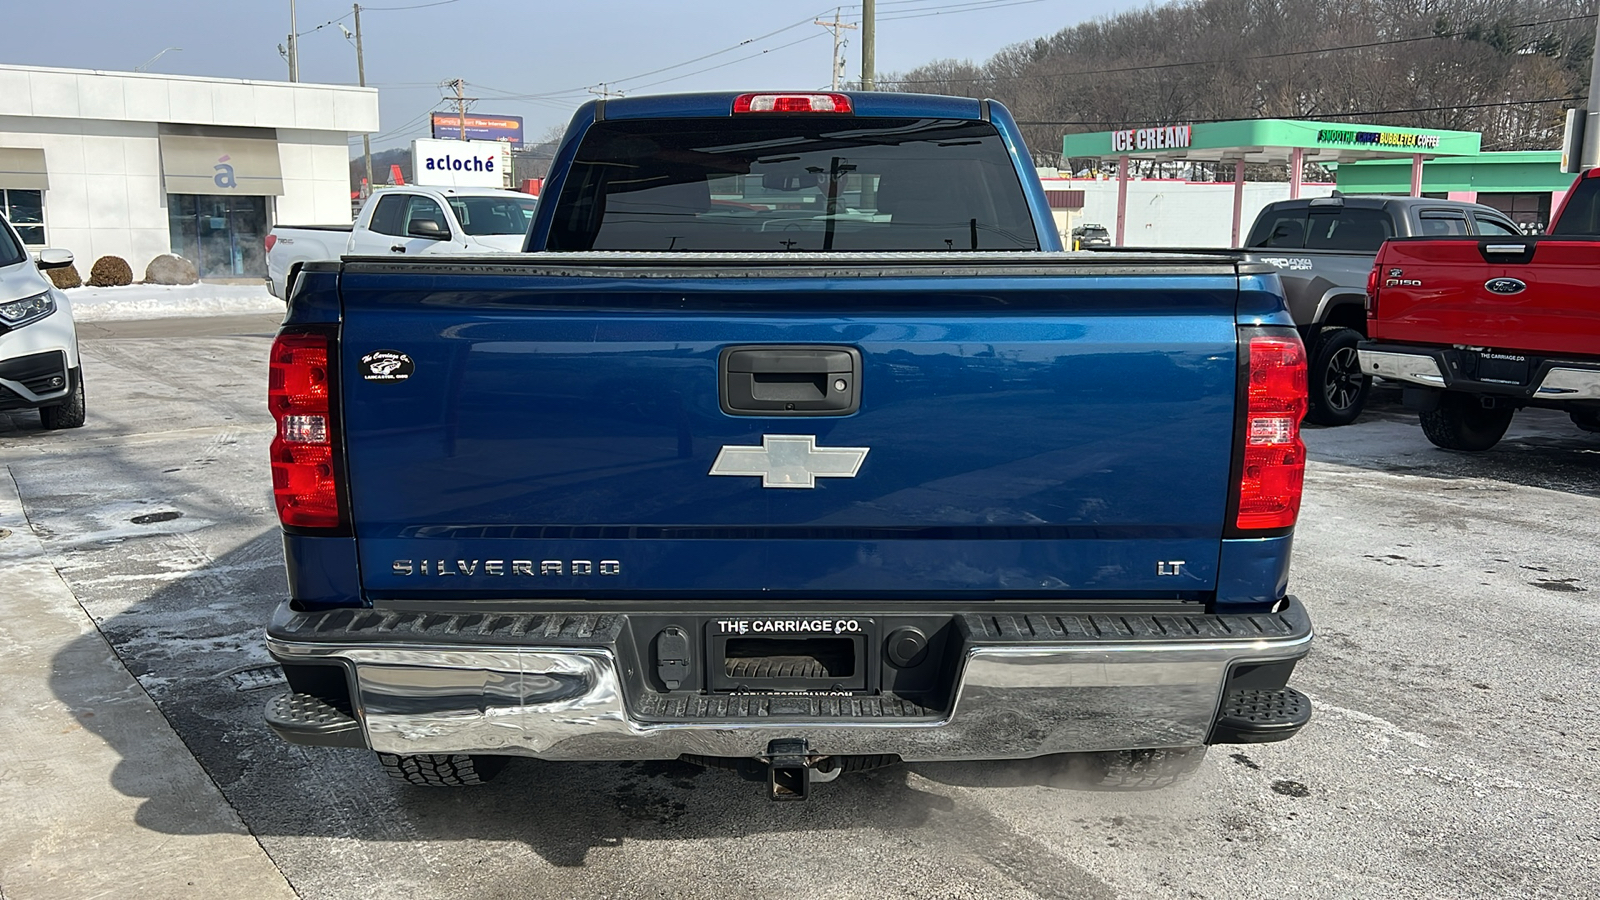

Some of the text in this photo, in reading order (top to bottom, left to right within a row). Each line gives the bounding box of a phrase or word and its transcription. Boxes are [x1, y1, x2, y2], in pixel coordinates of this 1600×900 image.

[1111, 125, 1191, 152] ICE CREAM
[1416, 134, 1440, 147] COFFEE
[426, 154, 494, 172] acloché
[1260, 257, 1289, 269] TRD
[391, 559, 620, 576] SILVERADO
[1157, 560, 1186, 576] LT
[717, 620, 862, 633] THE CARRIAGE CO.
